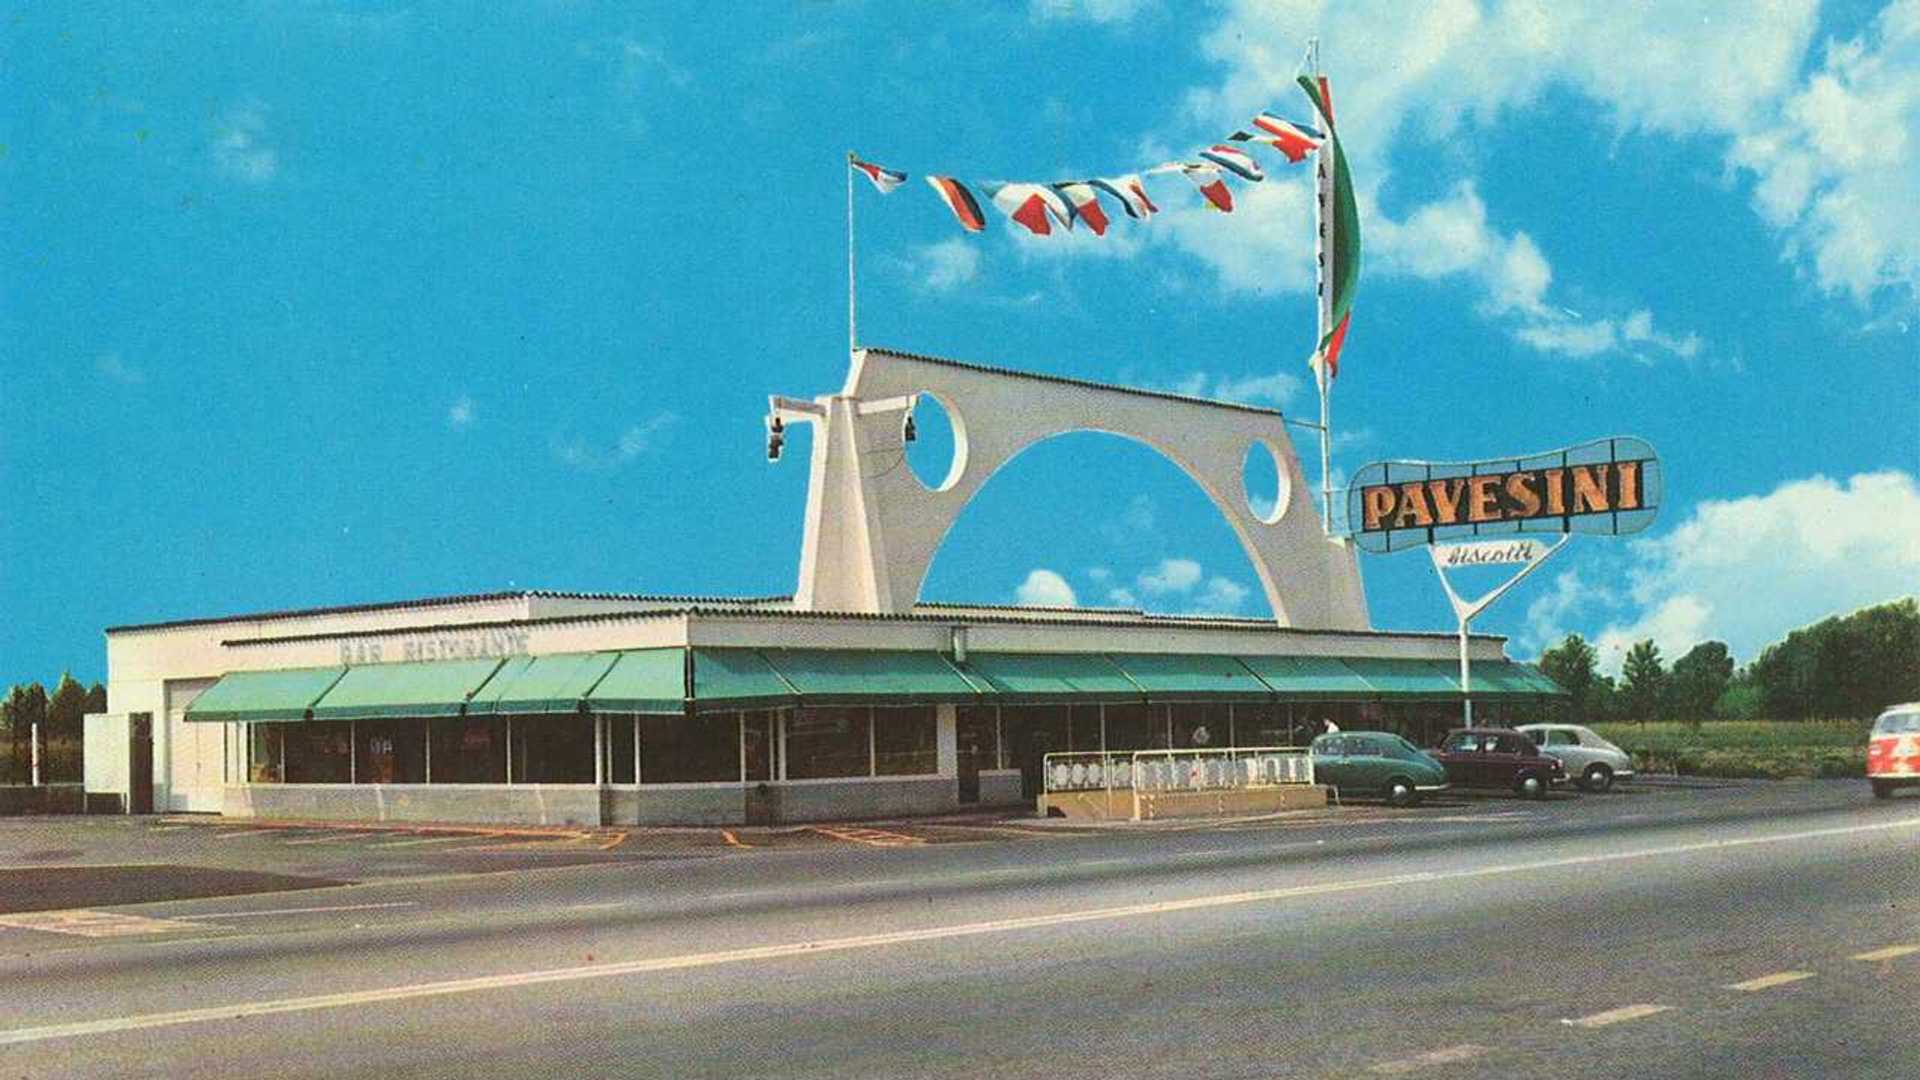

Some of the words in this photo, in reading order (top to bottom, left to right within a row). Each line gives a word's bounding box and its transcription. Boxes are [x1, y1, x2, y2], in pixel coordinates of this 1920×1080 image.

[1364, 462, 1639, 529] PAVESINI
[1446, 542, 1535, 567] biscotti
[340, 637, 382, 665] BAR
